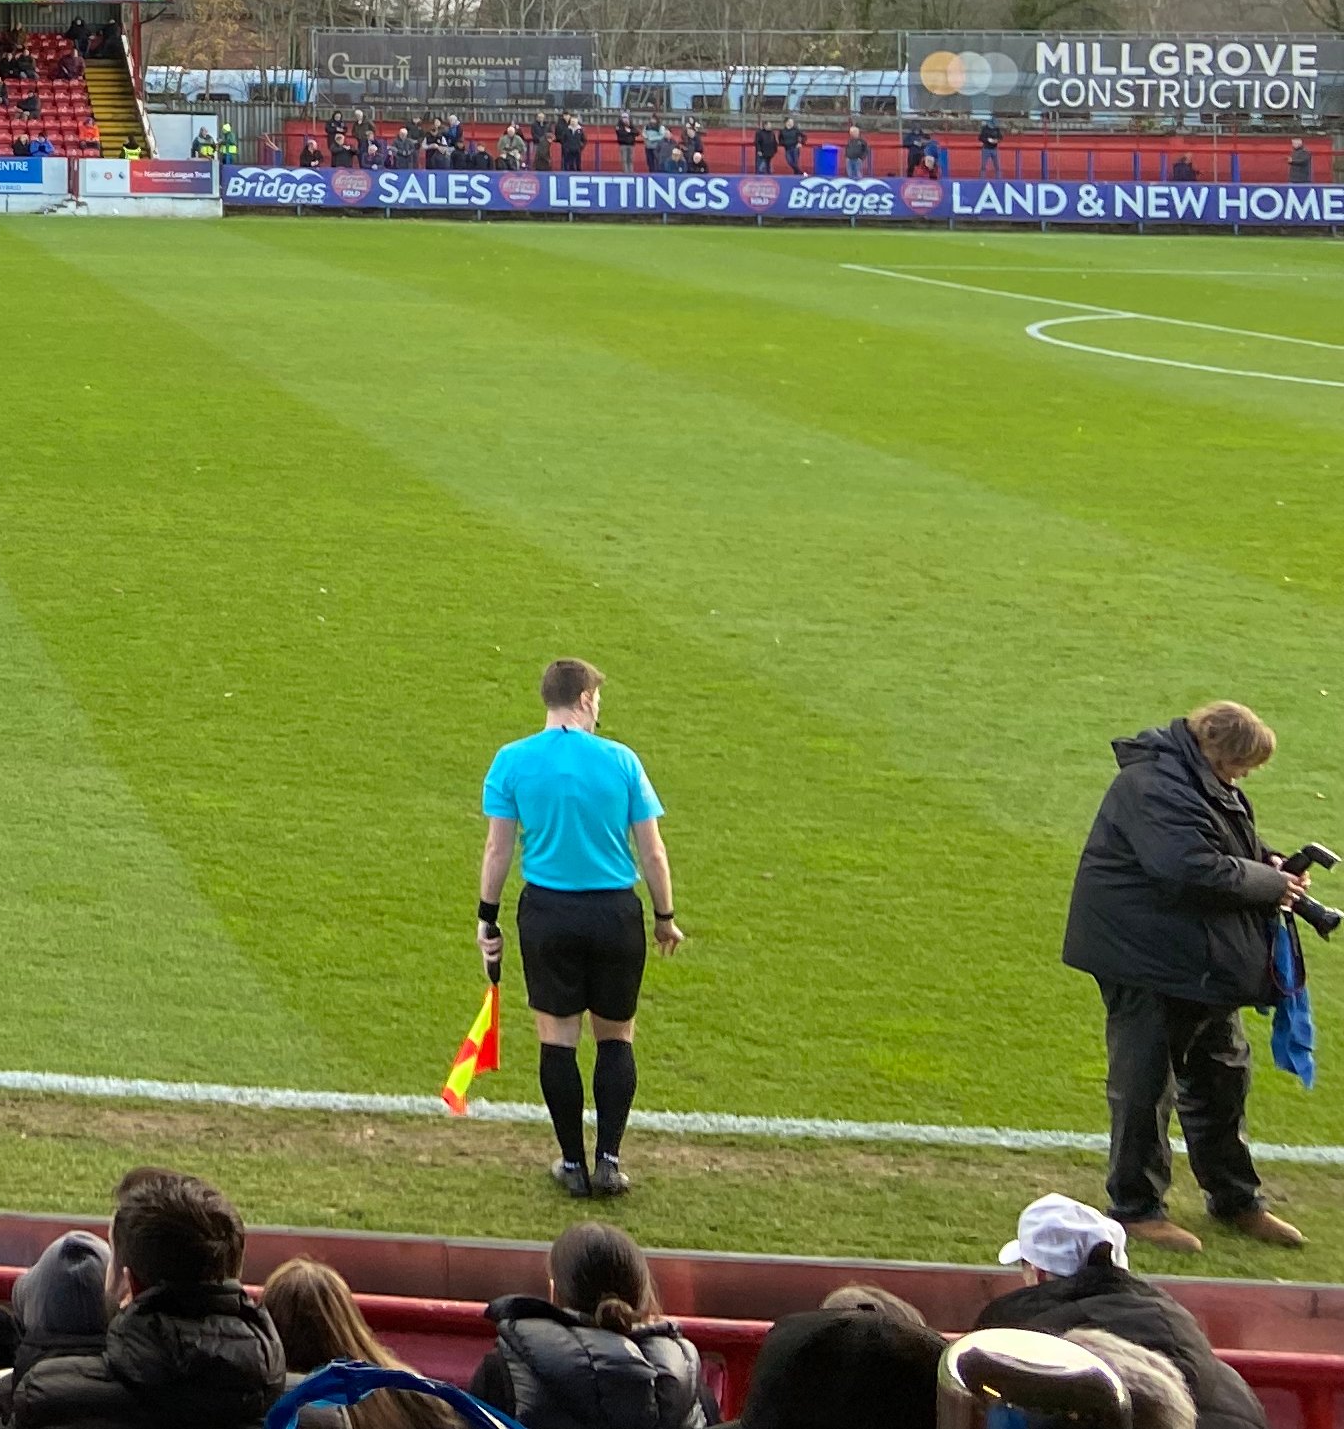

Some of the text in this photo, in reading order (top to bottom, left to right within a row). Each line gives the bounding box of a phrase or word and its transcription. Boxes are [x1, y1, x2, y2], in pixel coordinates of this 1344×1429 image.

[437, 56, 521, 66] RESTAURANT
[1036, 41, 1318, 77] MILLGROVE
[437, 78, 486, 87] EVENTS
[1037, 78, 1316, 110] CONSTRUCTION
[226, 175, 327, 204] Bridges
[378, 172, 492, 205] SALES
[548, 175, 730, 210] LETTINGS
[787, 185, 895, 215] Bridges
[952, 181, 1067, 217] LAND
[1076, 183, 1106, 218] &
[1114, 185, 1209, 220] NEW
